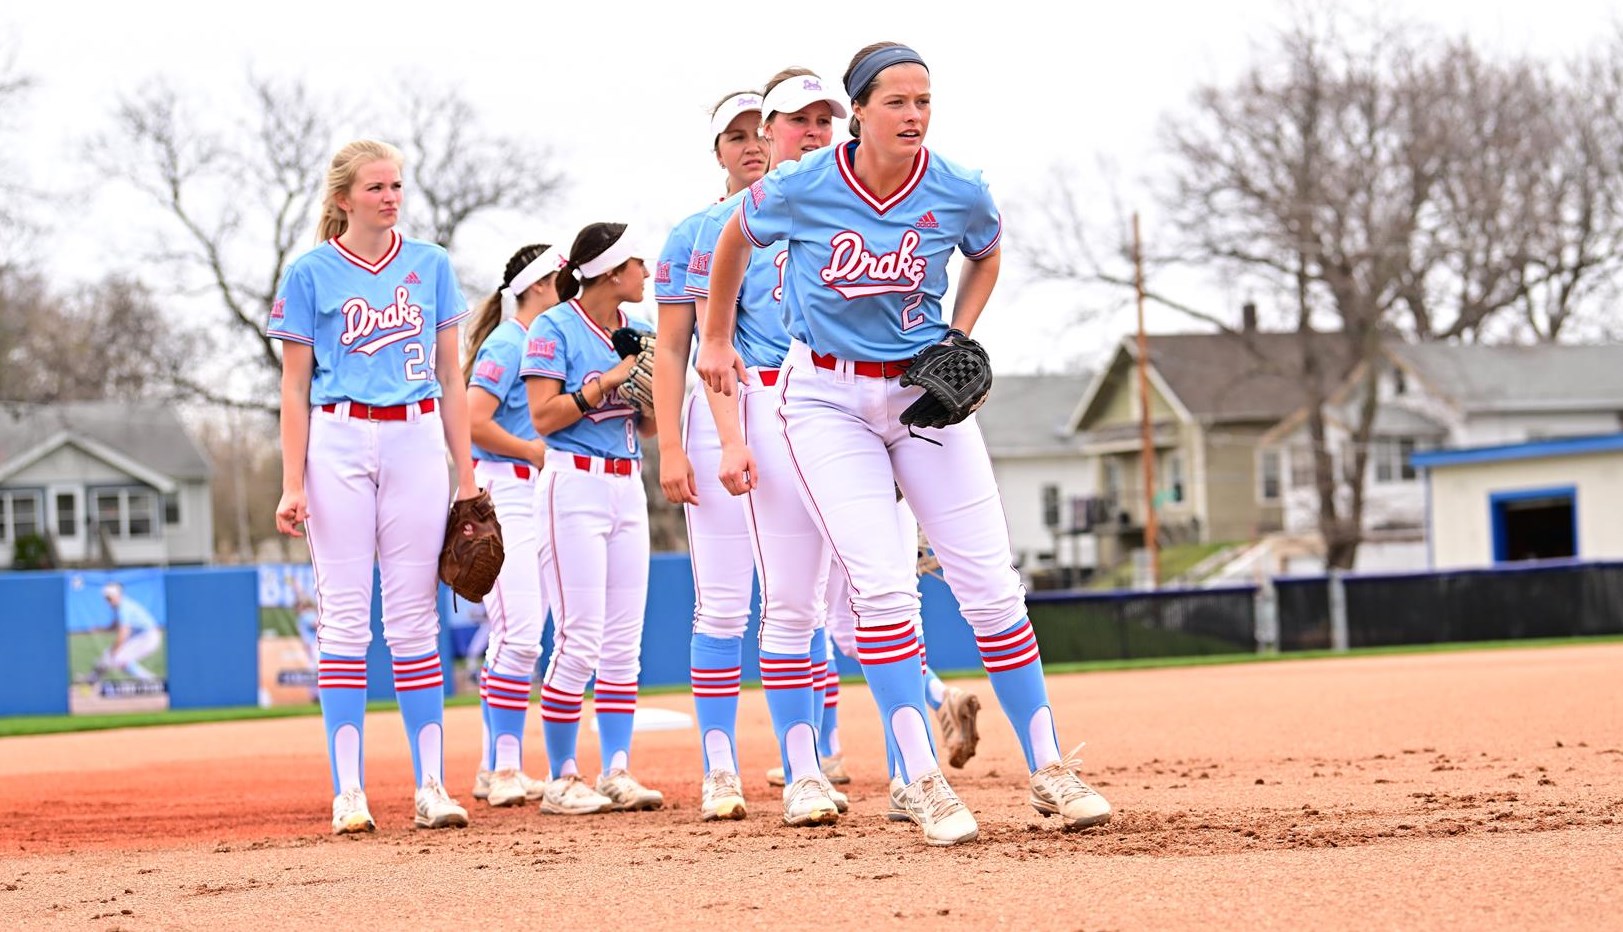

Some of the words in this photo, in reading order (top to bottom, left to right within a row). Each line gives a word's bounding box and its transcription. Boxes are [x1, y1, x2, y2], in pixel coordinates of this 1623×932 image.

[820, 229, 928, 288] Drake
[340, 286, 424, 347] Drake
[900, 292, 925, 332] 2
